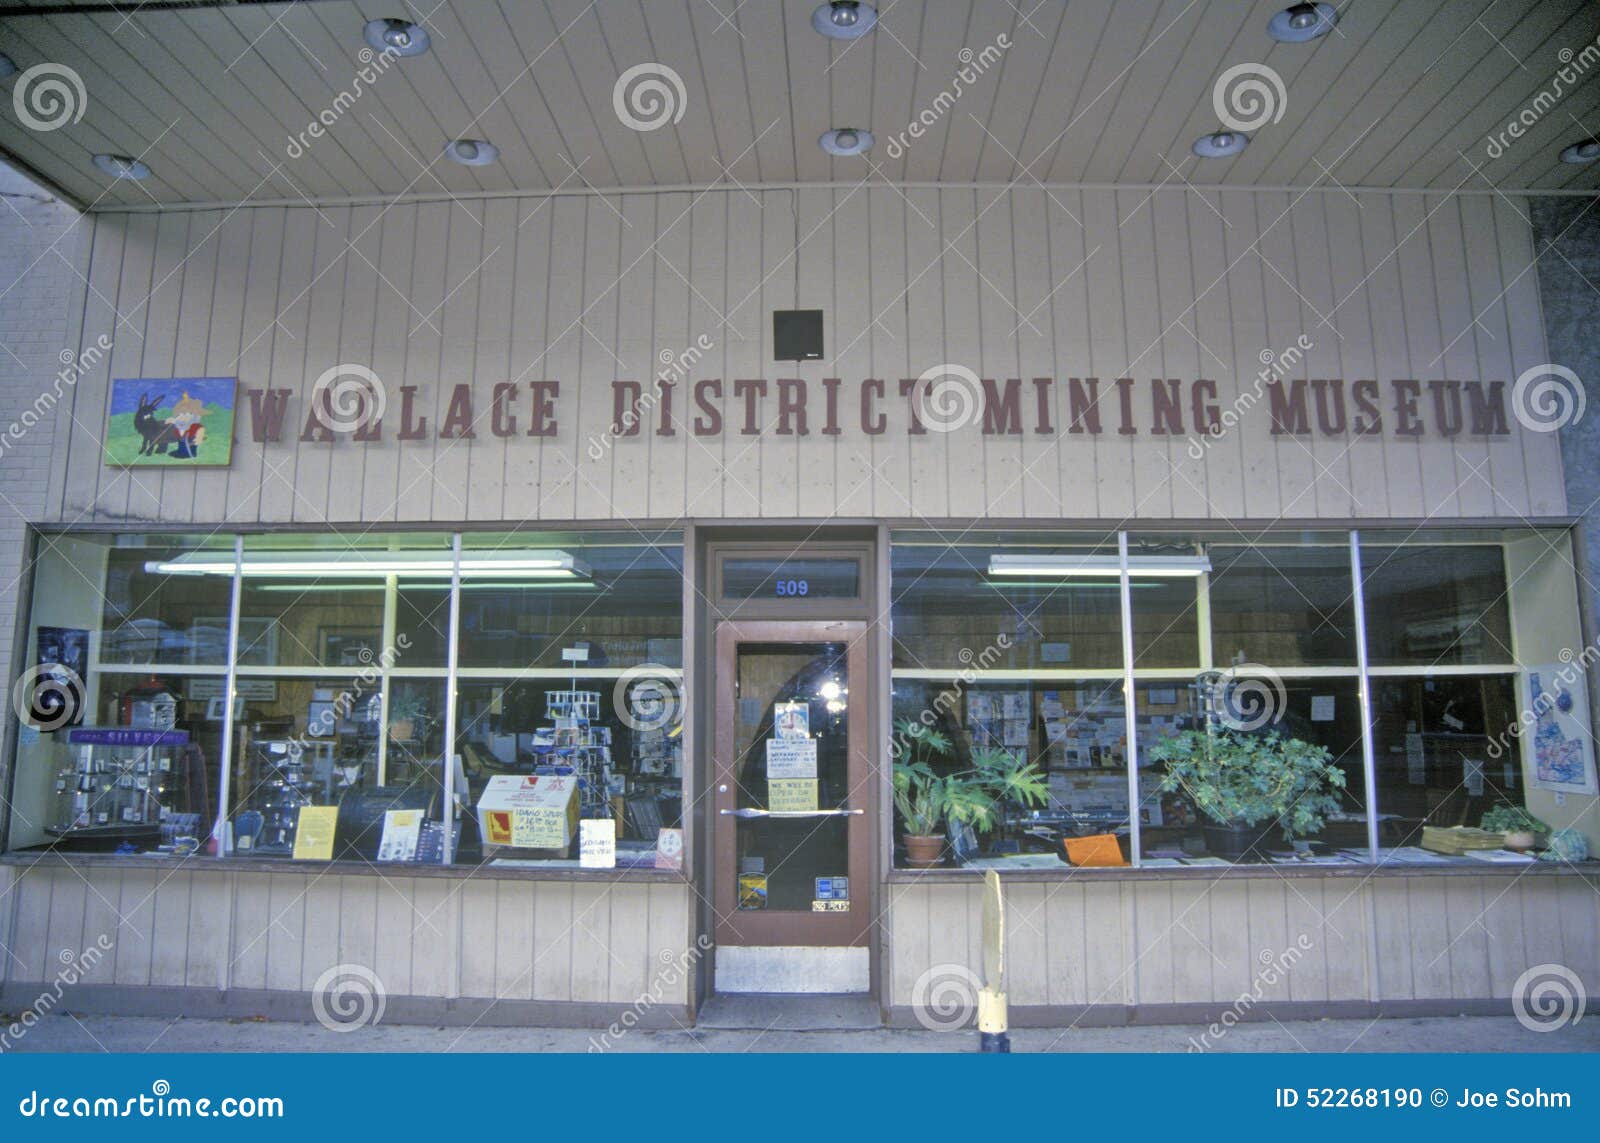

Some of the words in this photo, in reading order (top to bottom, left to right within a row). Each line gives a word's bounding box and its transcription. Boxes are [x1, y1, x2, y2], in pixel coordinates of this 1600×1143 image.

[249, 380, 560, 442] WALLACE
[611, 378, 933, 438] DISTRICT
[980, 377, 1221, 437] MINING
[1268, 379, 1511, 438] MUSEUM
[776, 580, 809, 596] 509
